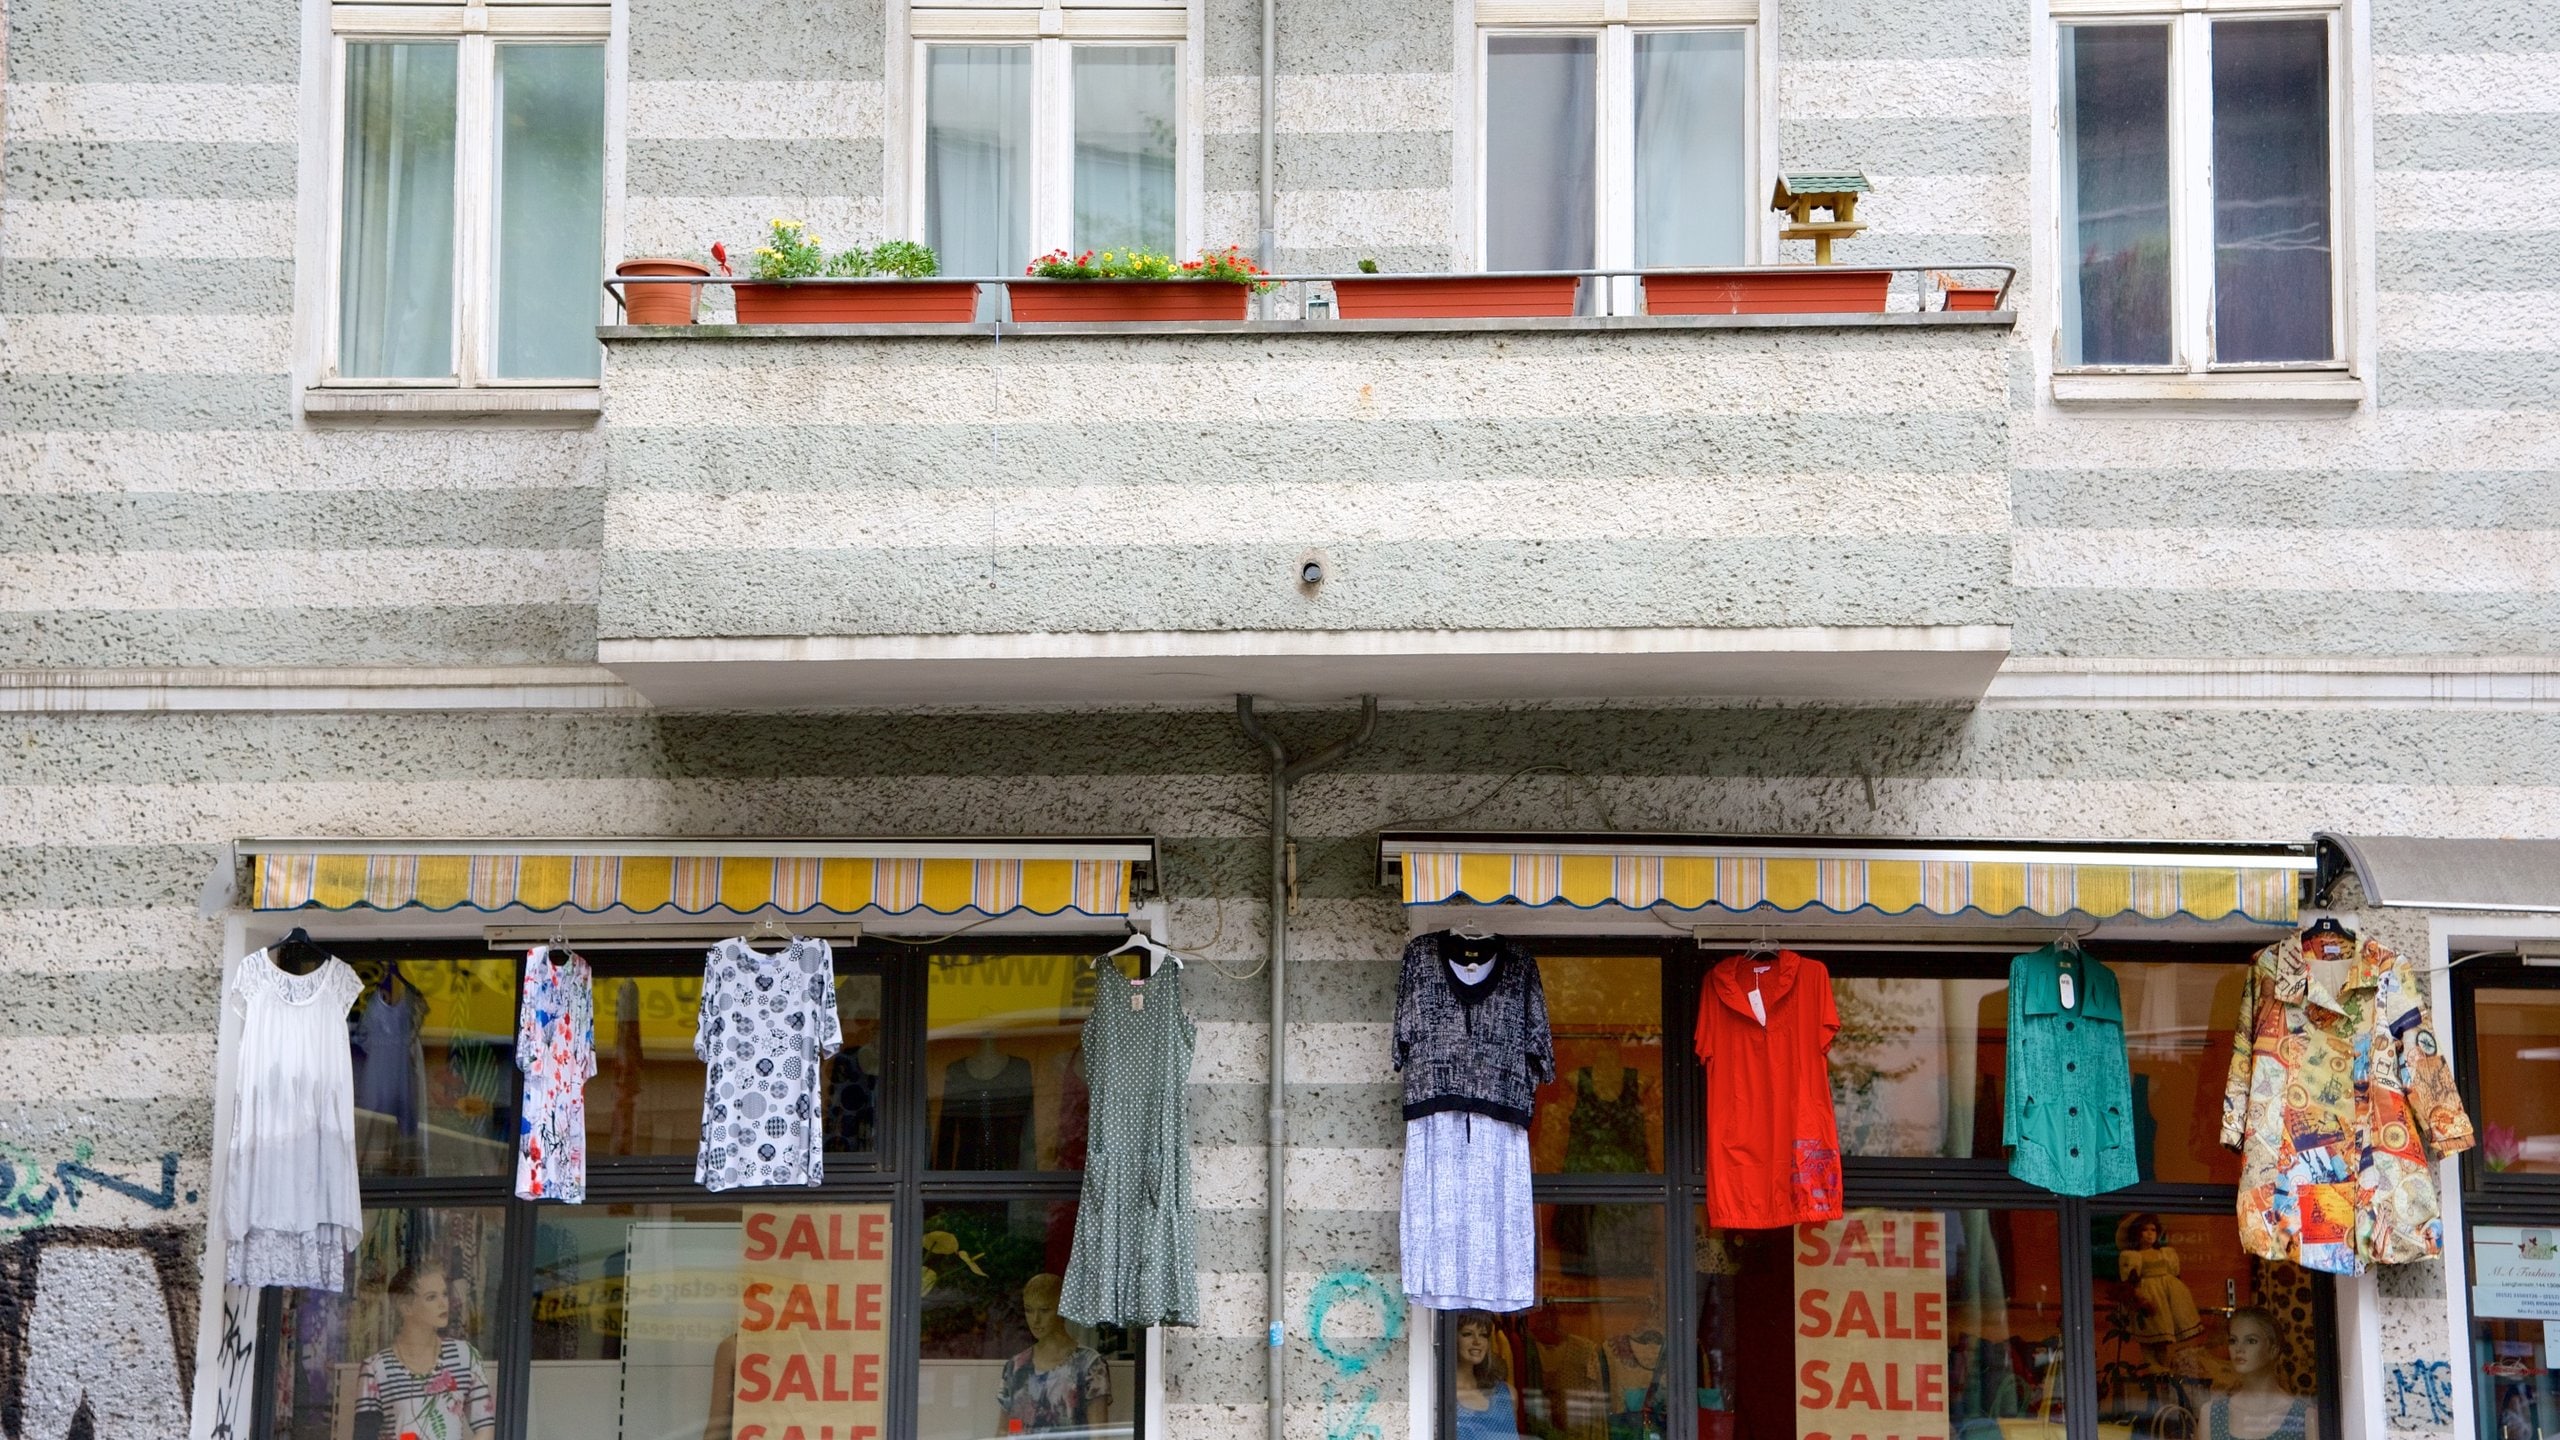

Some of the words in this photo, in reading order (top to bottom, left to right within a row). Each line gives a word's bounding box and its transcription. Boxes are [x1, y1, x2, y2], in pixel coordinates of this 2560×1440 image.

[744, 1213, 885, 1261] SALE
[1797, 1220, 1941, 1269] SALE
[2516, 1266, 2556, 1278] Fashion
[740, 1282, 882, 1332] SALE
[1799, 1290, 1942, 1340] SALE
[737, 1353, 880, 1403] SALE
[1800, 1361, 1944, 1412] SALE
